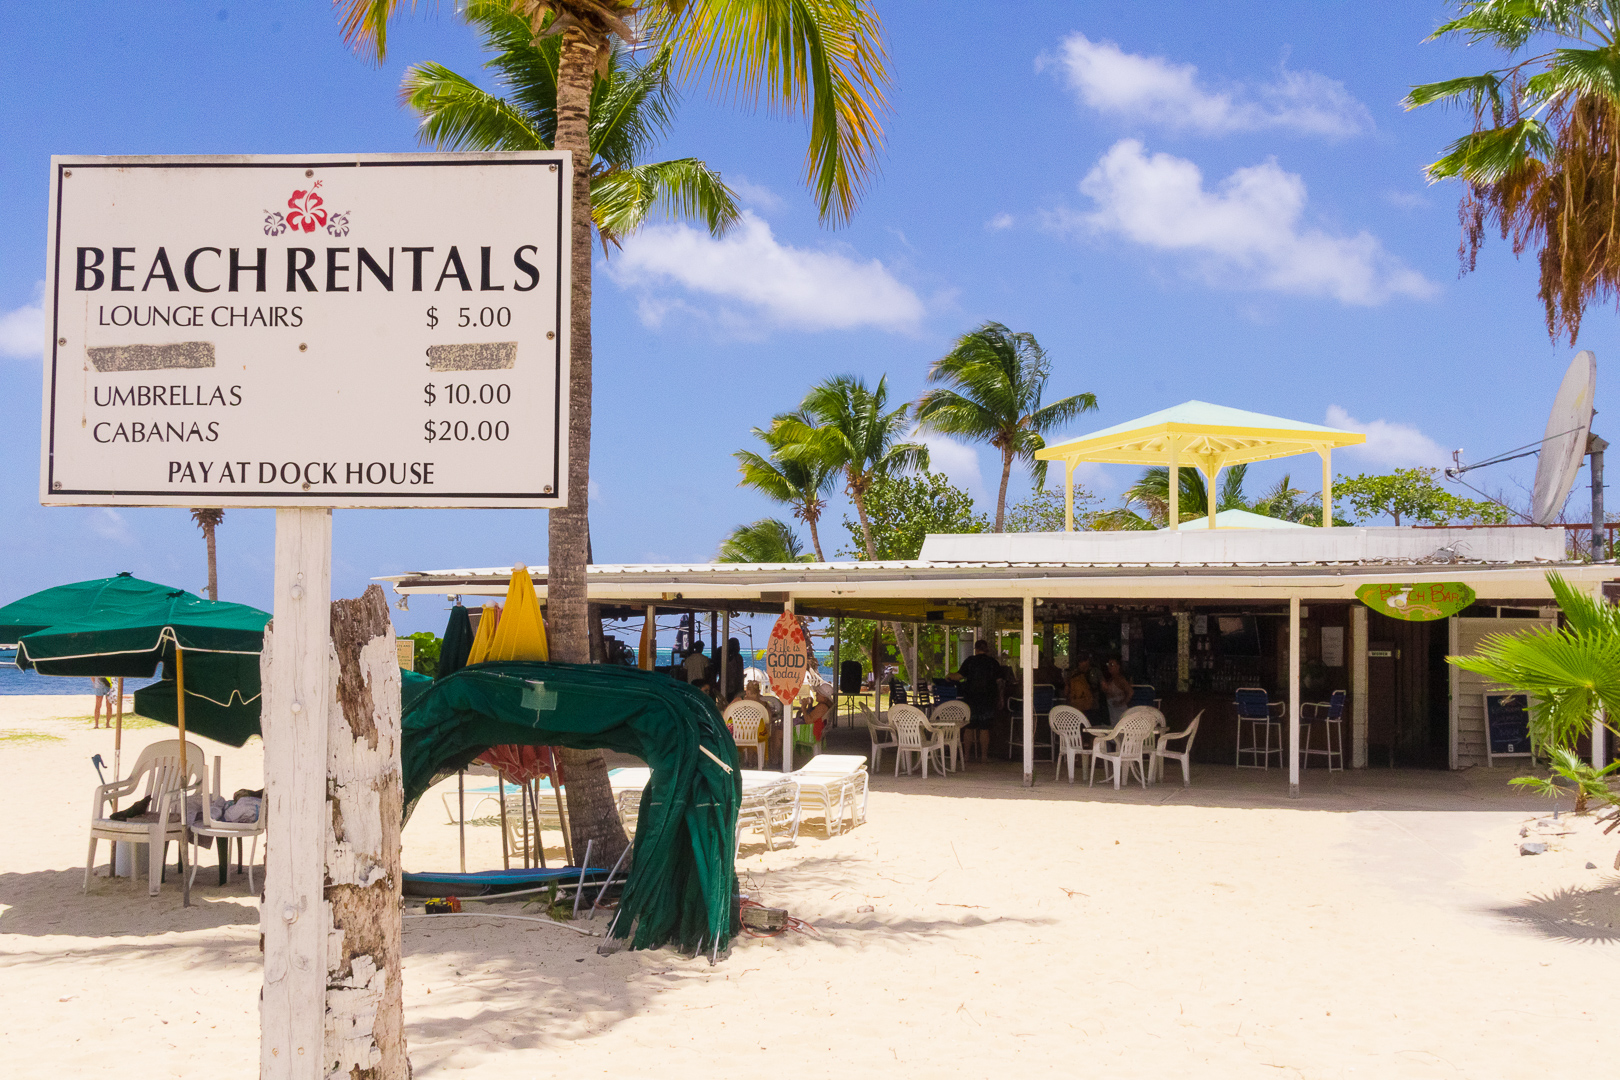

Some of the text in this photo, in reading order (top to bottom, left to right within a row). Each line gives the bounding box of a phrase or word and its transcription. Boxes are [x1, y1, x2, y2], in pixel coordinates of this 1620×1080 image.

[75, 245, 540, 293] BEACH RENTALS
[99, 305, 303, 328] LOUNGE CHAIRS
[426, 306, 512, 329] $ 5.00
[94, 385, 242, 407] UMBRELLAS
[94, 421, 220, 444] CABANAS
[168, 462, 434, 486] PAY AT DOCK HOUSE
[1430, 584, 1460, 602] BAR
[769, 639, 800, 655] Life is
[768, 654, 805, 668] GOOD
[772, 667, 800, 683] today
